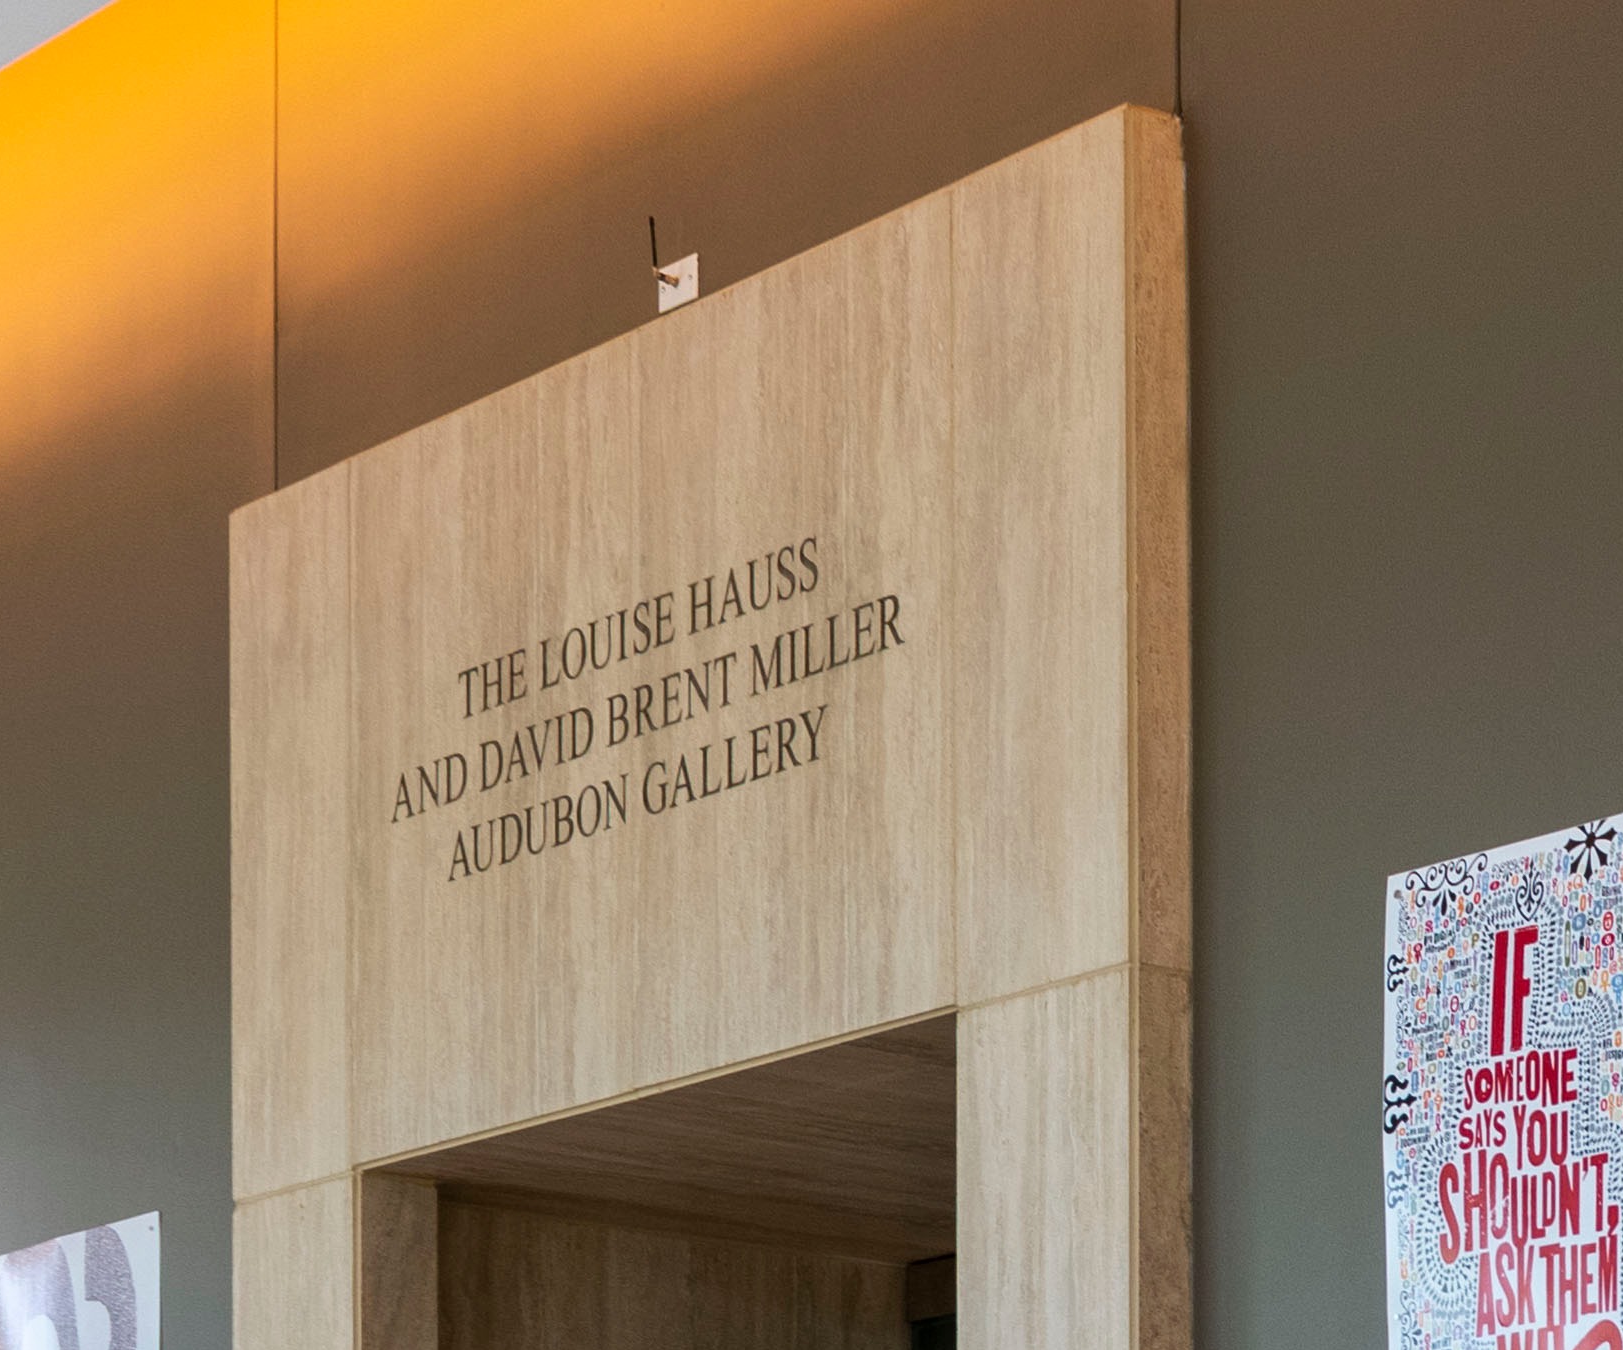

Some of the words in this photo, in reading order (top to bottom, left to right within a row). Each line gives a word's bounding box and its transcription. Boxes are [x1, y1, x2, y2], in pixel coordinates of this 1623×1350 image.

[458, 648, 529, 719] THE
[539, 591, 676, 691] LOUISE
[687, 536, 820, 636] HAUSS
[390, 751, 468, 824] AND
[479, 705, 594, 793] DAVID
[606, 651, 737, 748] BRENT
[750, 593, 906, 697] MILLER
[447, 773, 628, 882] AUDUBON
[641, 703, 828, 815] GALLERY
[1490, 924, 1538, 1057] IF
[1459, 1106, 1506, 1150] SAYS
[1512, 1106, 1568, 1170] YOU
[1464, 1049, 1577, 1111] SOMEONE
[1439, 1152, 1620, 1266] SHOULDN'T,
[1477, 1242, 1536, 1337] ASK
[1539, 1235, 1618, 1327] THEM
